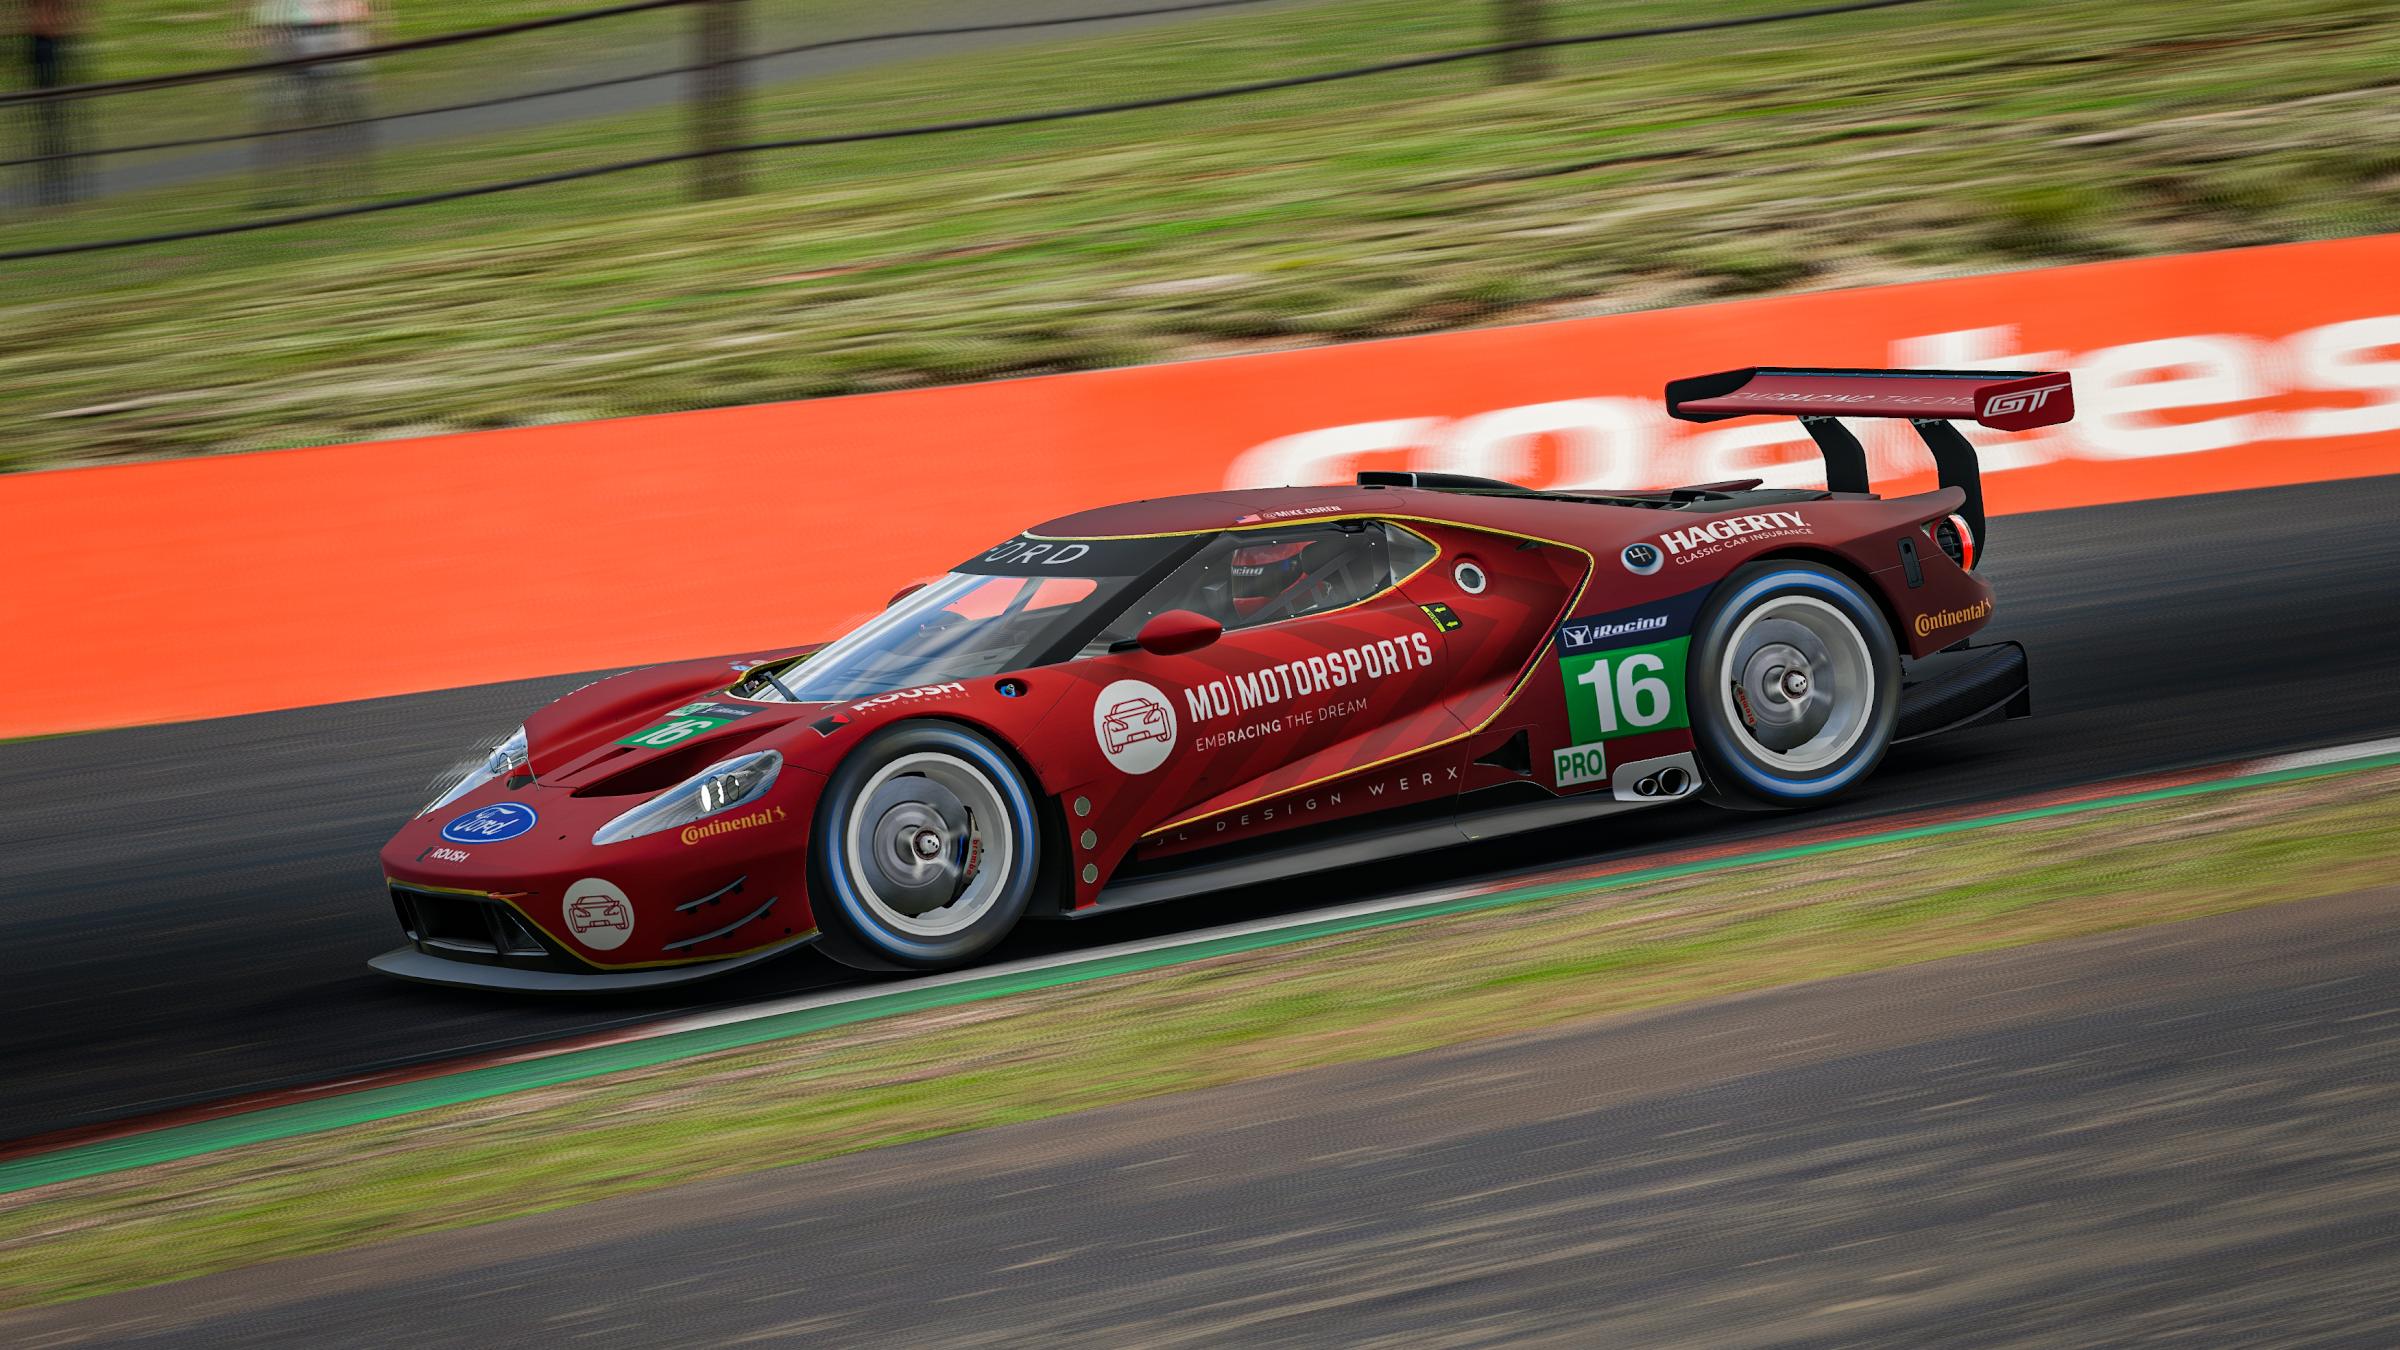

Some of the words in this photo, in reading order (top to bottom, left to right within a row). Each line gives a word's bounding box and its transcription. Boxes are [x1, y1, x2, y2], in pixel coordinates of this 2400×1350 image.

[1983, 382, 2071, 417] GT
[1659, 511, 1806, 555] HAGERTY
[1675, 544, 1722, 566] CLASSIC
[1724, 536, 1749, 548] CAR
[1749, 528, 1814, 542] INSURANCE
[984, 540, 1090, 565] ORD
[1593, 614, 1670, 639] iRacing
[1914, 600, 1986, 637] Continental
[1577, 653, 1671, 733] 16
[1196, 719, 1282, 752] EMBRACING
[1285, 711, 1314, 729] THE
[1318, 698, 1368, 721] DREAM
[1557, 749, 1603, 781] PRO
[1216, 793, 1342, 832] DESIGN
[1368, 767, 1458, 797] WERX
[452, 806, 521, 836] Ford
[681, 808, 774, 846] Continental
[431, 848, 471, 863] ROUSH
